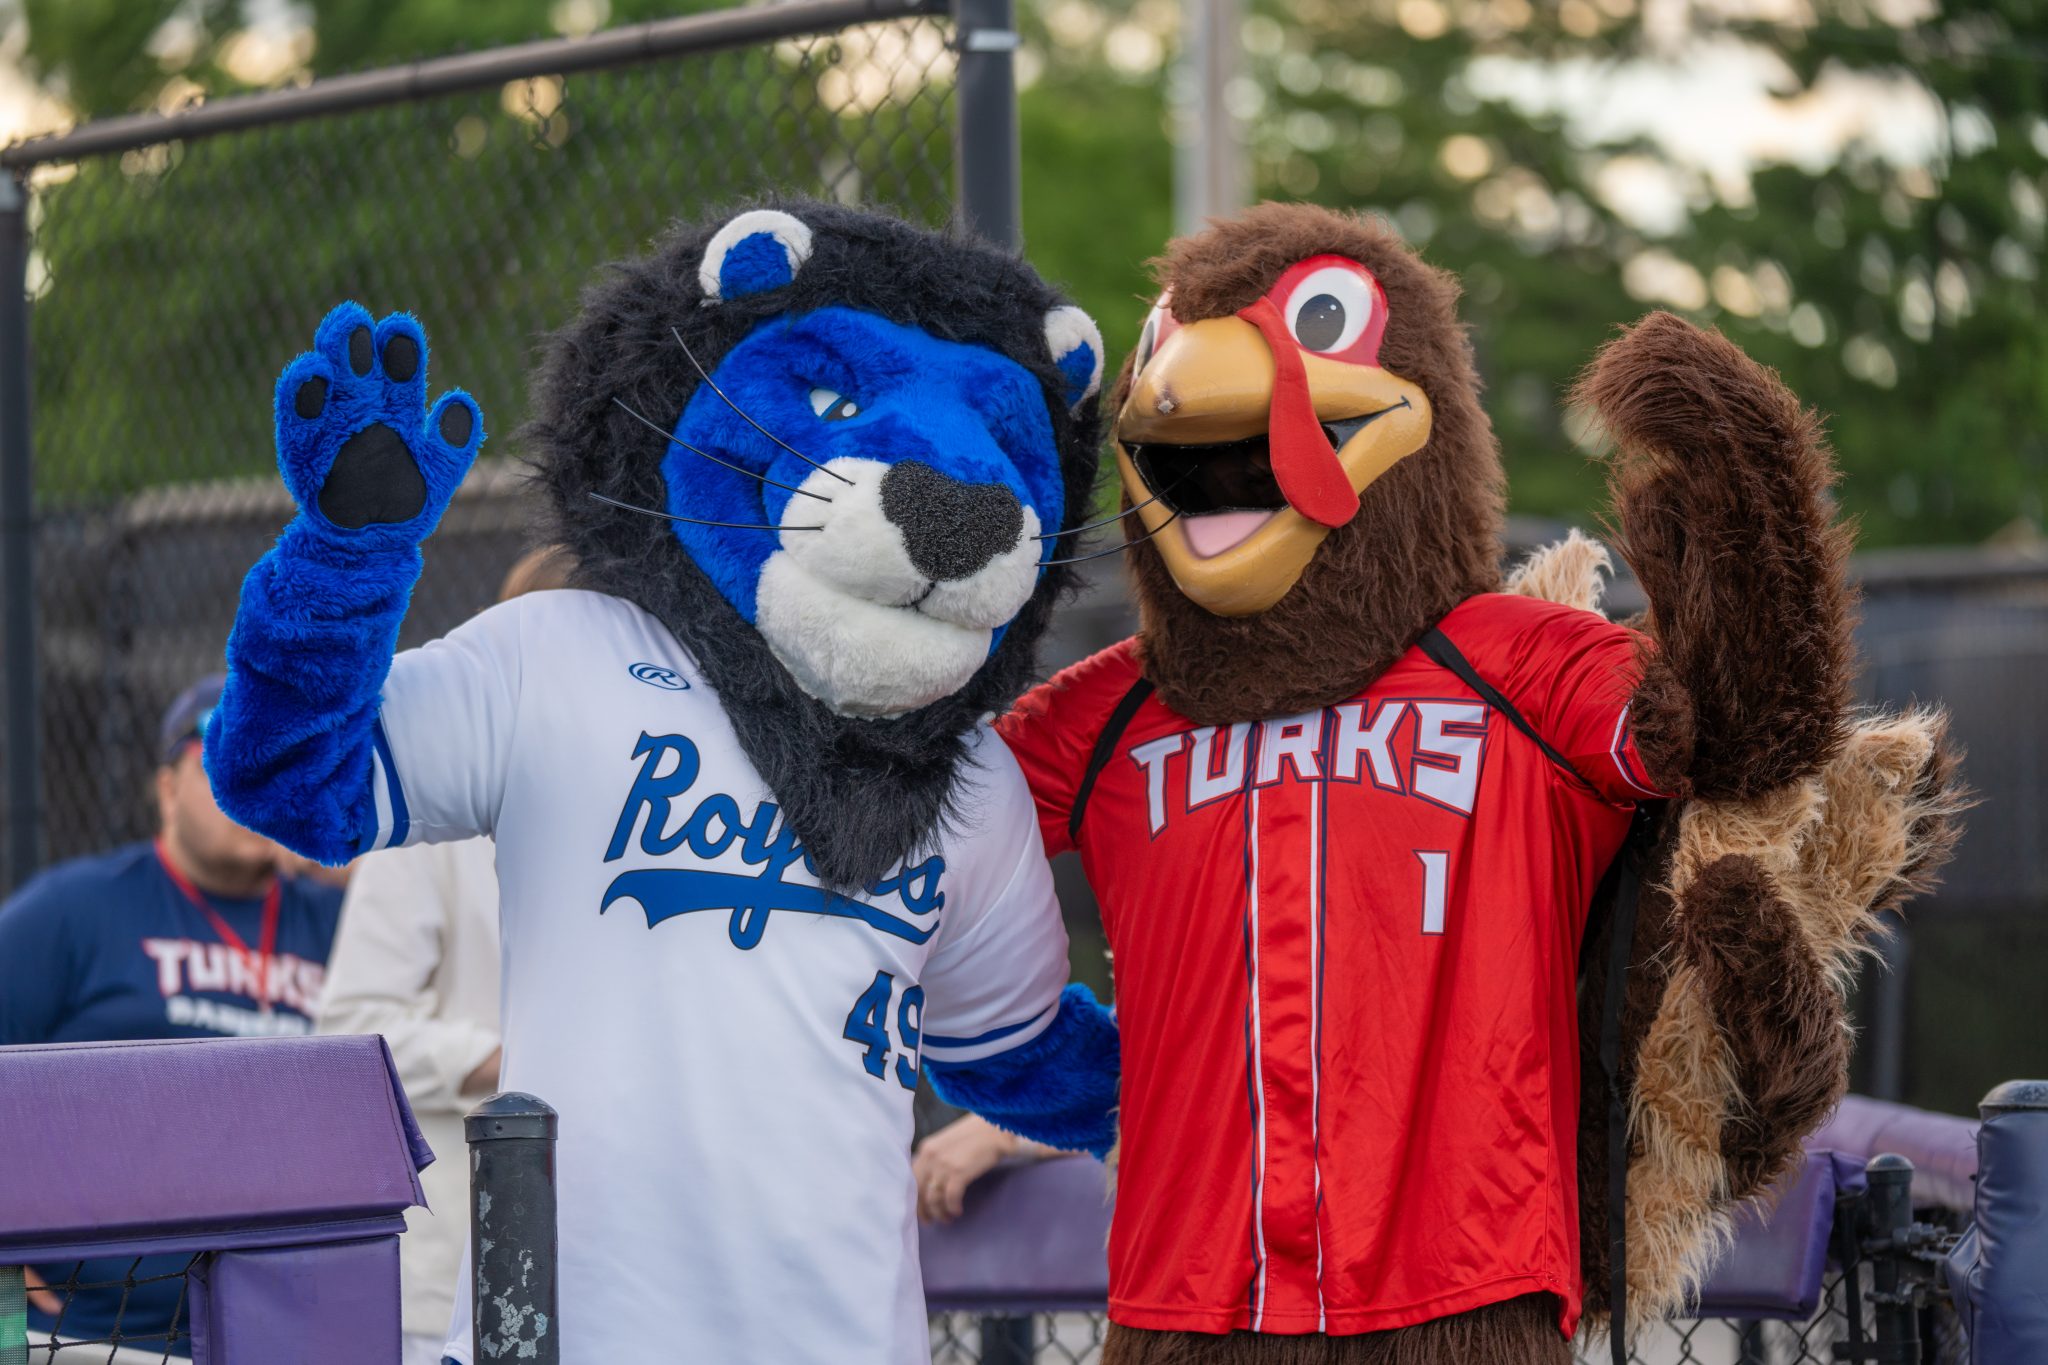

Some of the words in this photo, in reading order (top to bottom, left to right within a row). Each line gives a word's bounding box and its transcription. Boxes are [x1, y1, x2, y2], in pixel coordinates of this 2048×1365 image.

[1128, 697, 1490, 841] TURKS
[602, 730, 947, 951] Roys
[1412, 848, 1451, 937] 1
[842, 969, 926, 1092] 49
